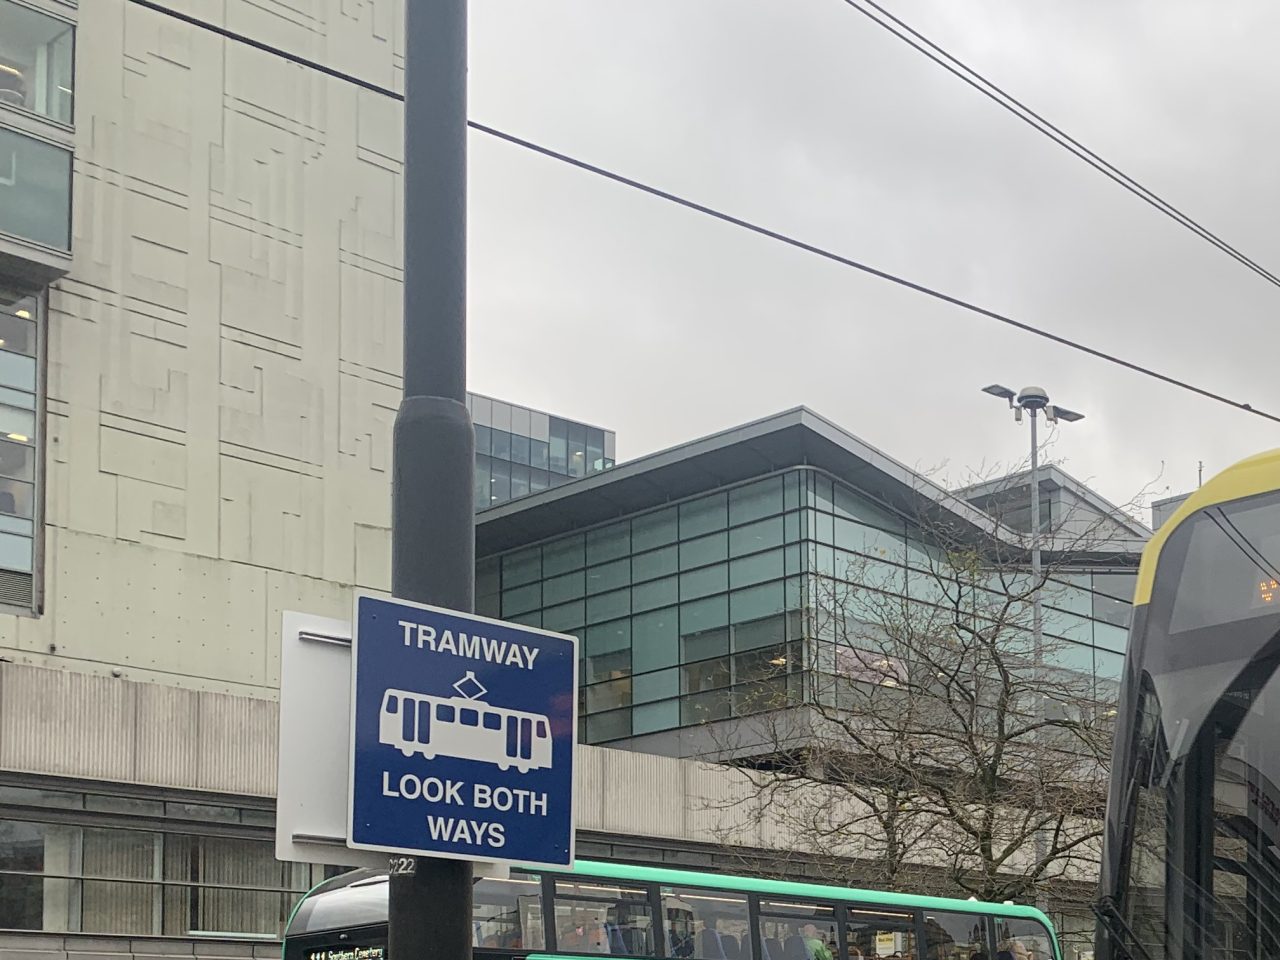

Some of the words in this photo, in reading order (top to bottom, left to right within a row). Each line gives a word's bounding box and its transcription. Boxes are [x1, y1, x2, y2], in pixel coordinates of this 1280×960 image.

[398, 621, 539, 670] TRAMWAY
[382, 771, 465, 806] LOOK
[473, 784, 548, 816] BOTH
[427, 815, 506, 848] WAYS
